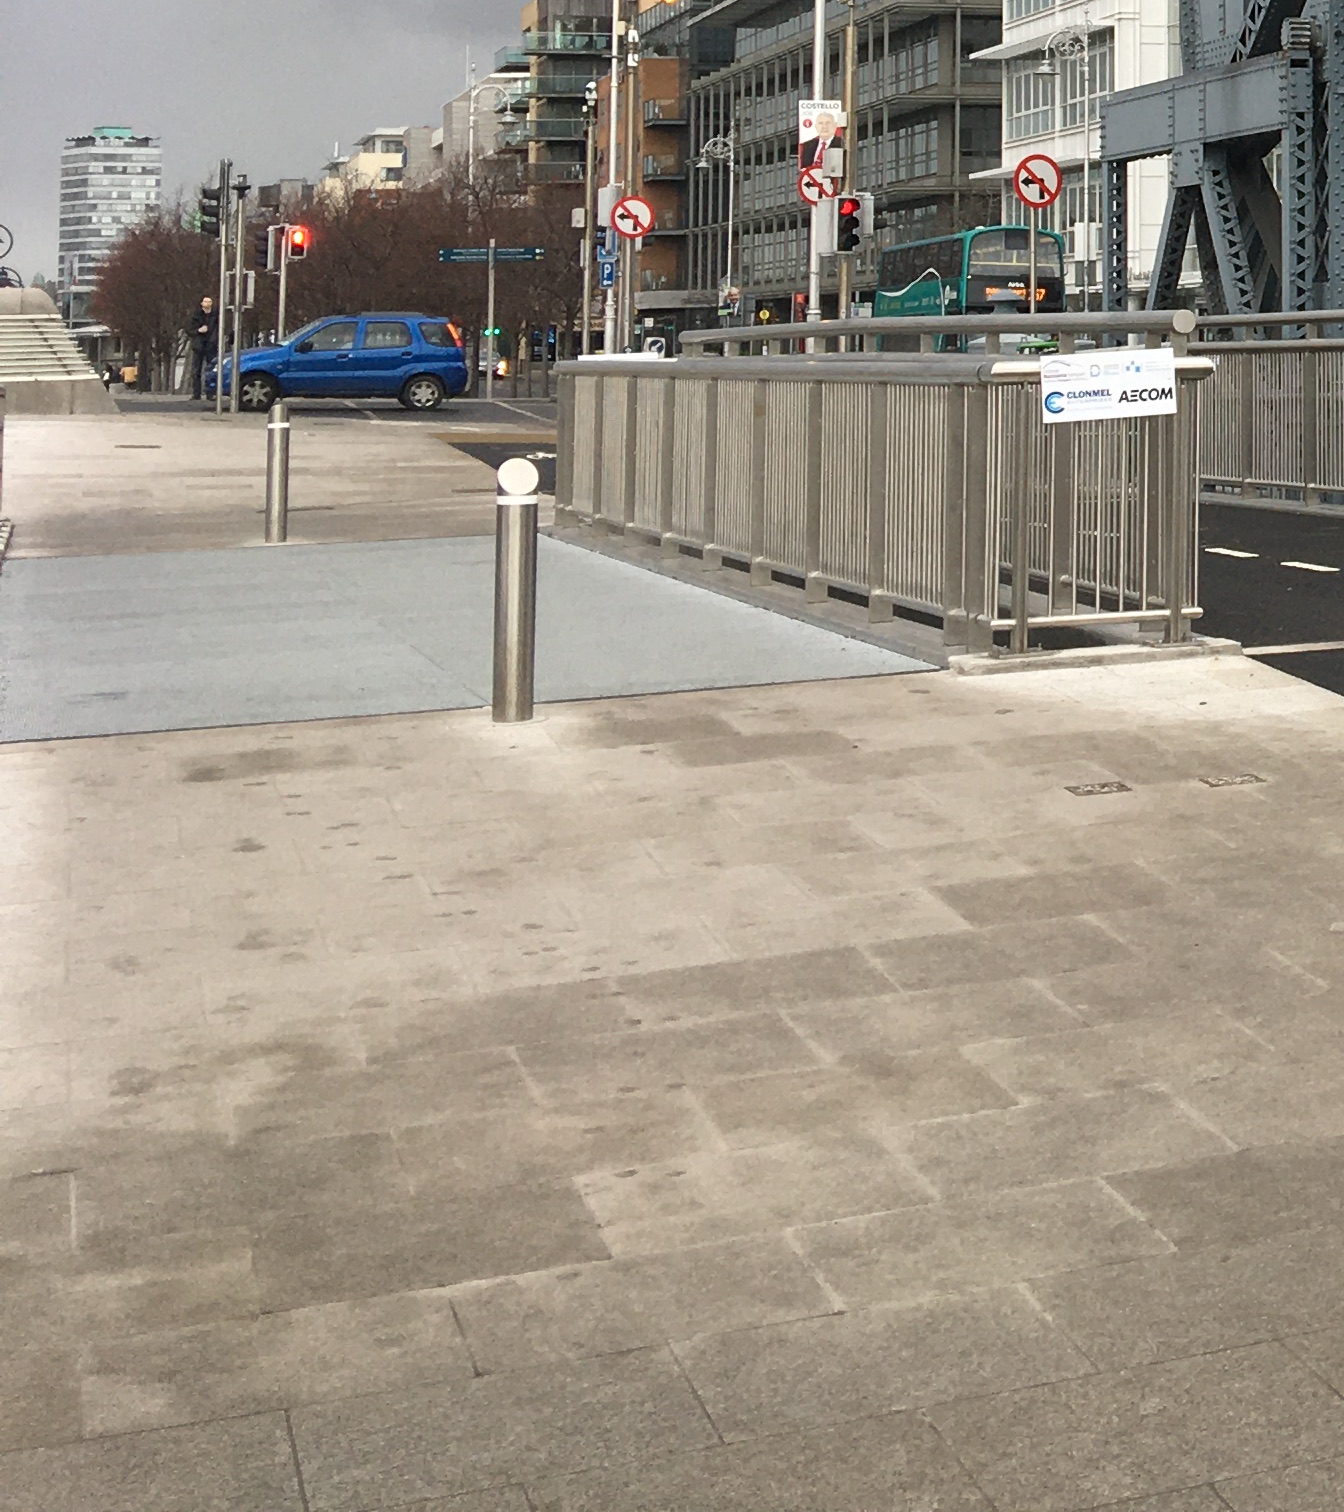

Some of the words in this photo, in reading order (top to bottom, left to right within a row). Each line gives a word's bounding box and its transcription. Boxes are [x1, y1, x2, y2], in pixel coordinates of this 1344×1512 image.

[801, 102, 840, 110] COSTELLO
[603, 264, 611, 278] P
[1066, 389, 1112, 399] CLONMEL
[1118, 387, 1173, 403] AECOM
